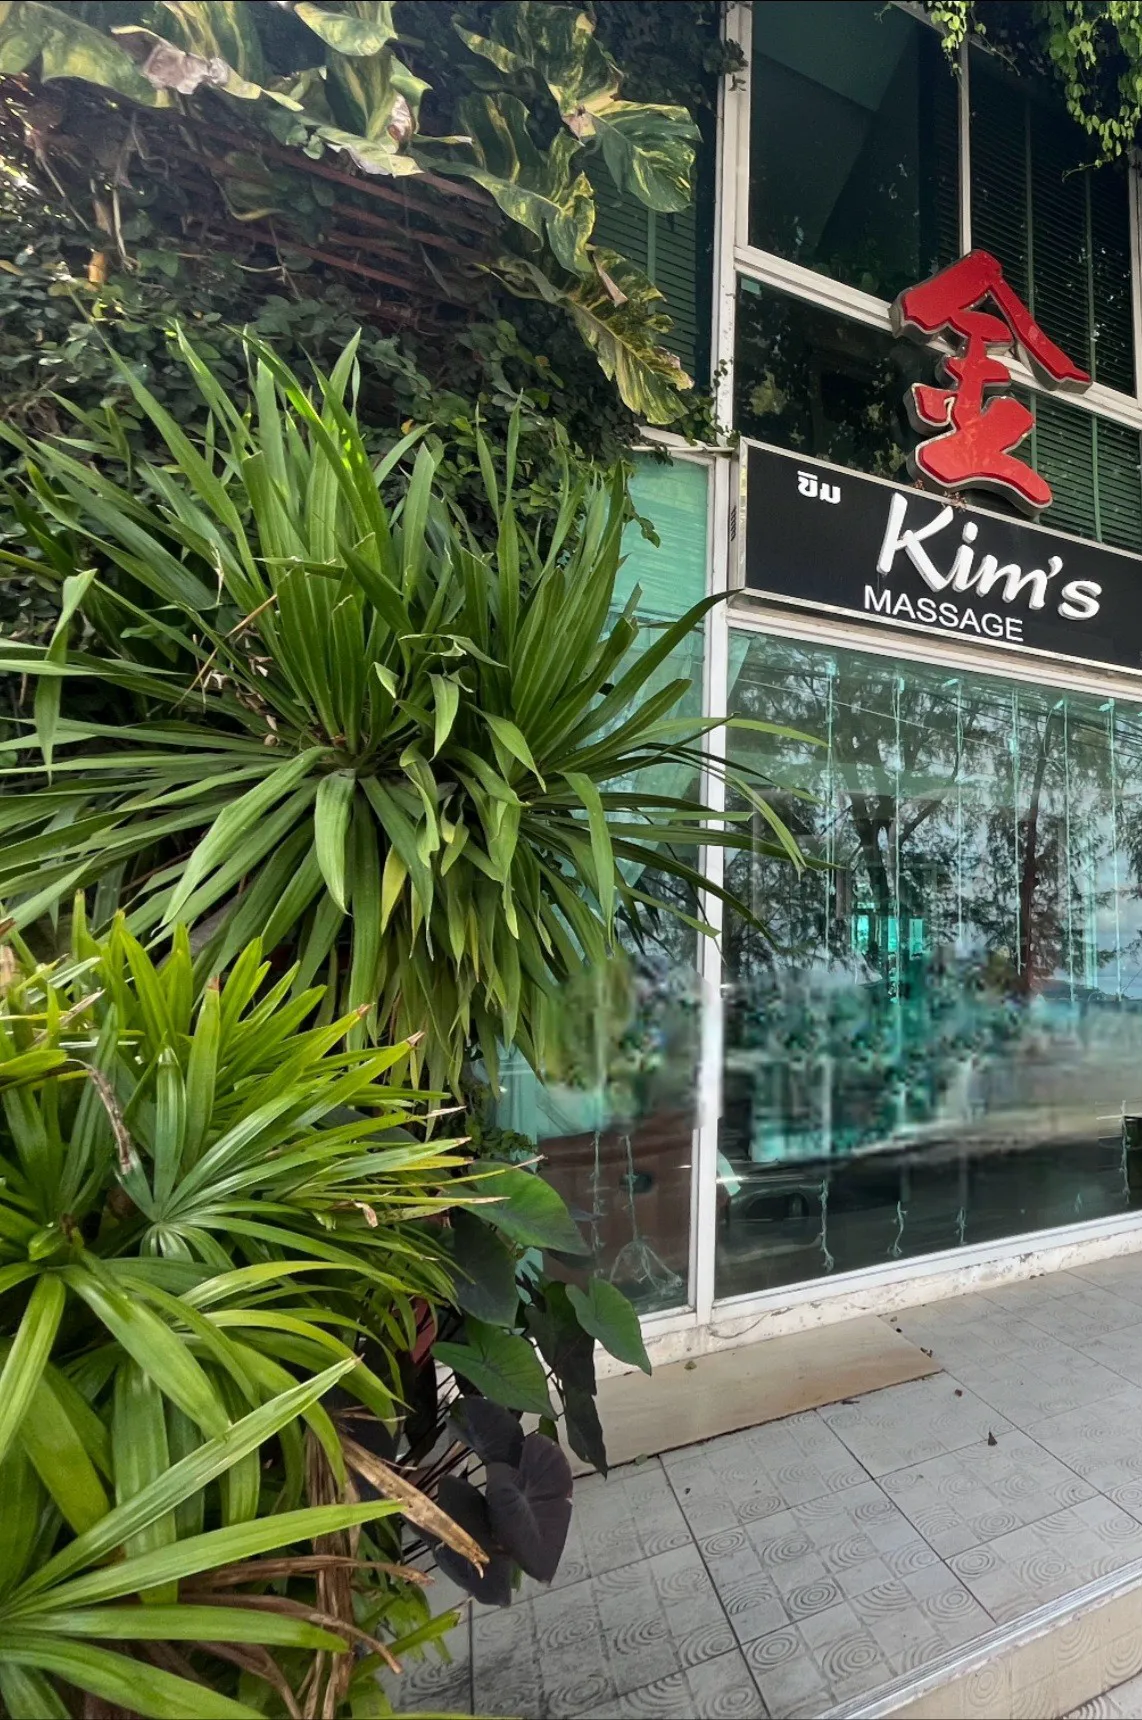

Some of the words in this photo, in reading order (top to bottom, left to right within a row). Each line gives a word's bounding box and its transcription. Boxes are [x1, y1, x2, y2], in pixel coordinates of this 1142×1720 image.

[797, 470, 842, 504] ขิม
[876, 491, 1103, 621] Kim's
[863, 585, 1024, 642] MASSAGE
